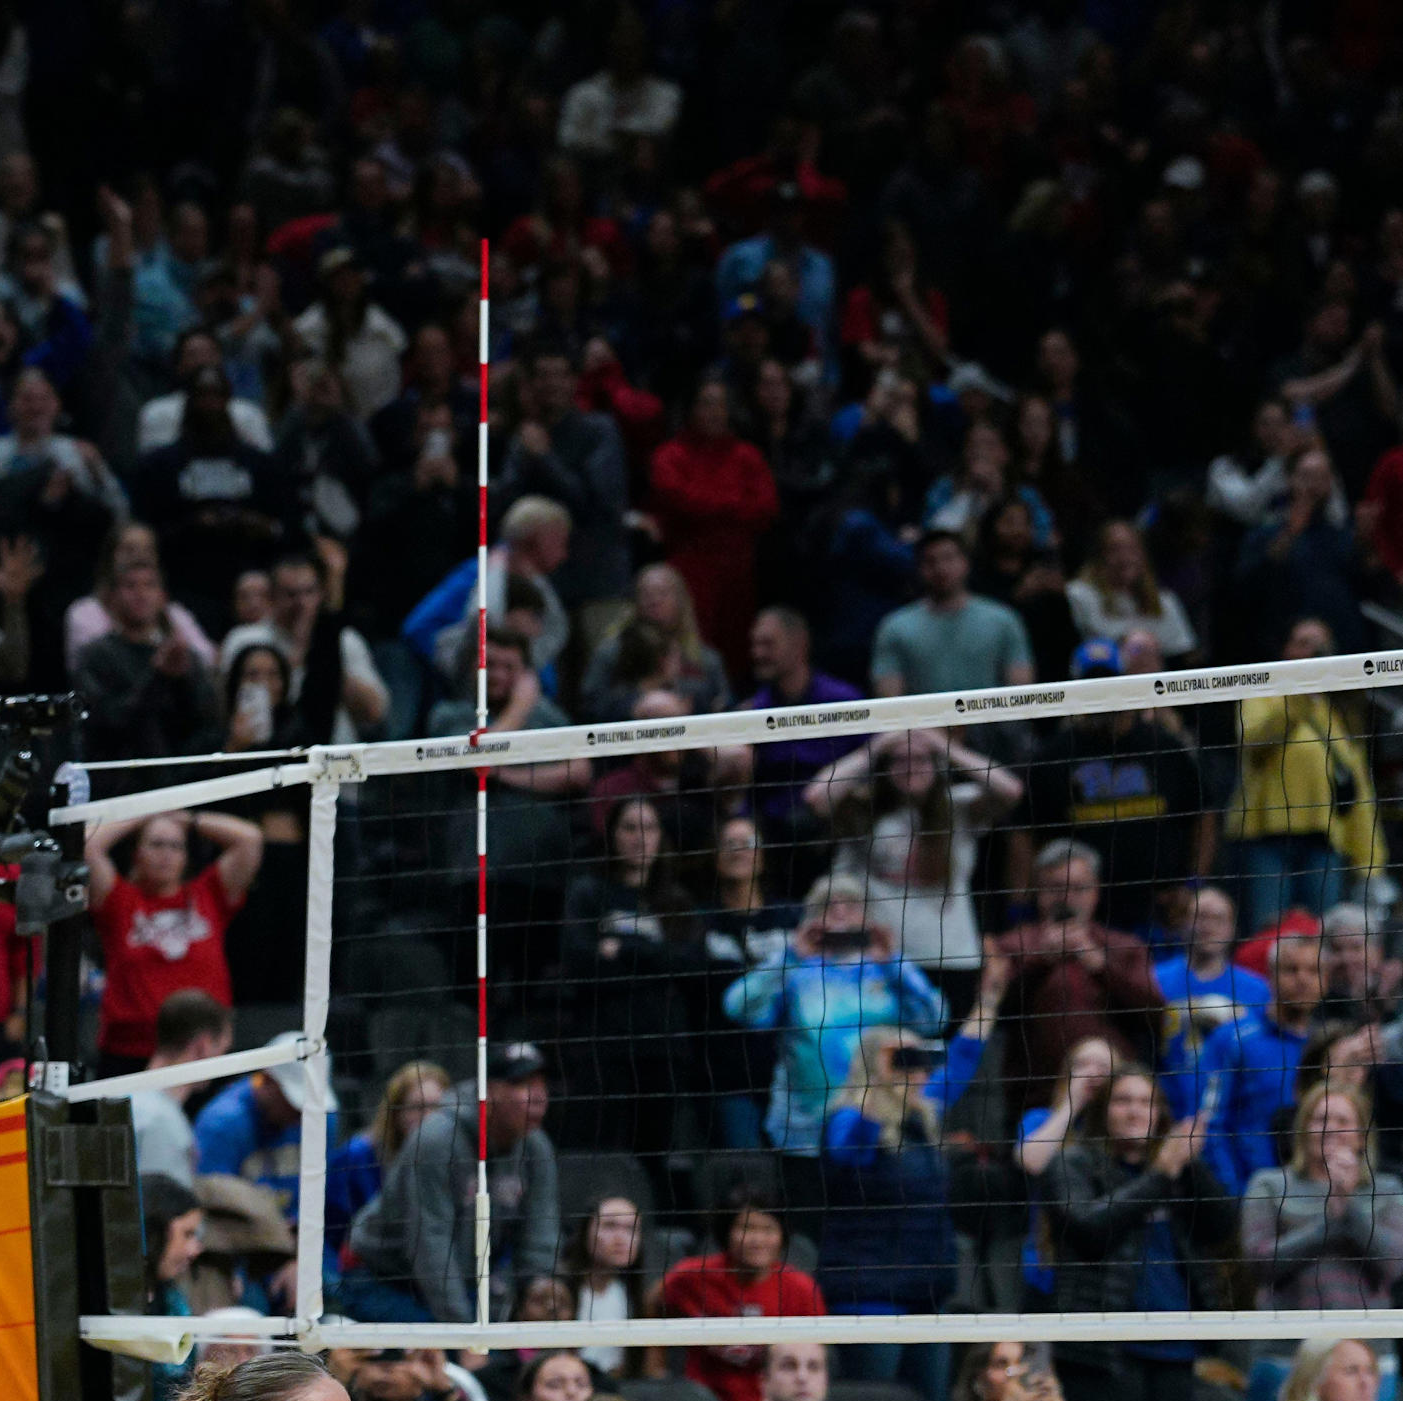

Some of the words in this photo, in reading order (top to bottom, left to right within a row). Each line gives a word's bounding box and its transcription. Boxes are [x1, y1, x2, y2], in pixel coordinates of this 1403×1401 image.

[1166, 677, 1210, 693] VOLLEYBALL
[1211, 672, 1270, 689] CHAMPIONSHIP
[966, 695, 1008, 711] VOLLEYBALL
[1010, 690, 1066, 707] CHAMPIONSHIP
[776, 714, 817, 729] VOLLEYBALL
[818, 709, 871, 725] CHAMPIONSHIP
[597, 731, 634, 745] VOLLEYBALL
[636, 726, 687, 740] CHAMPIONSHIP
